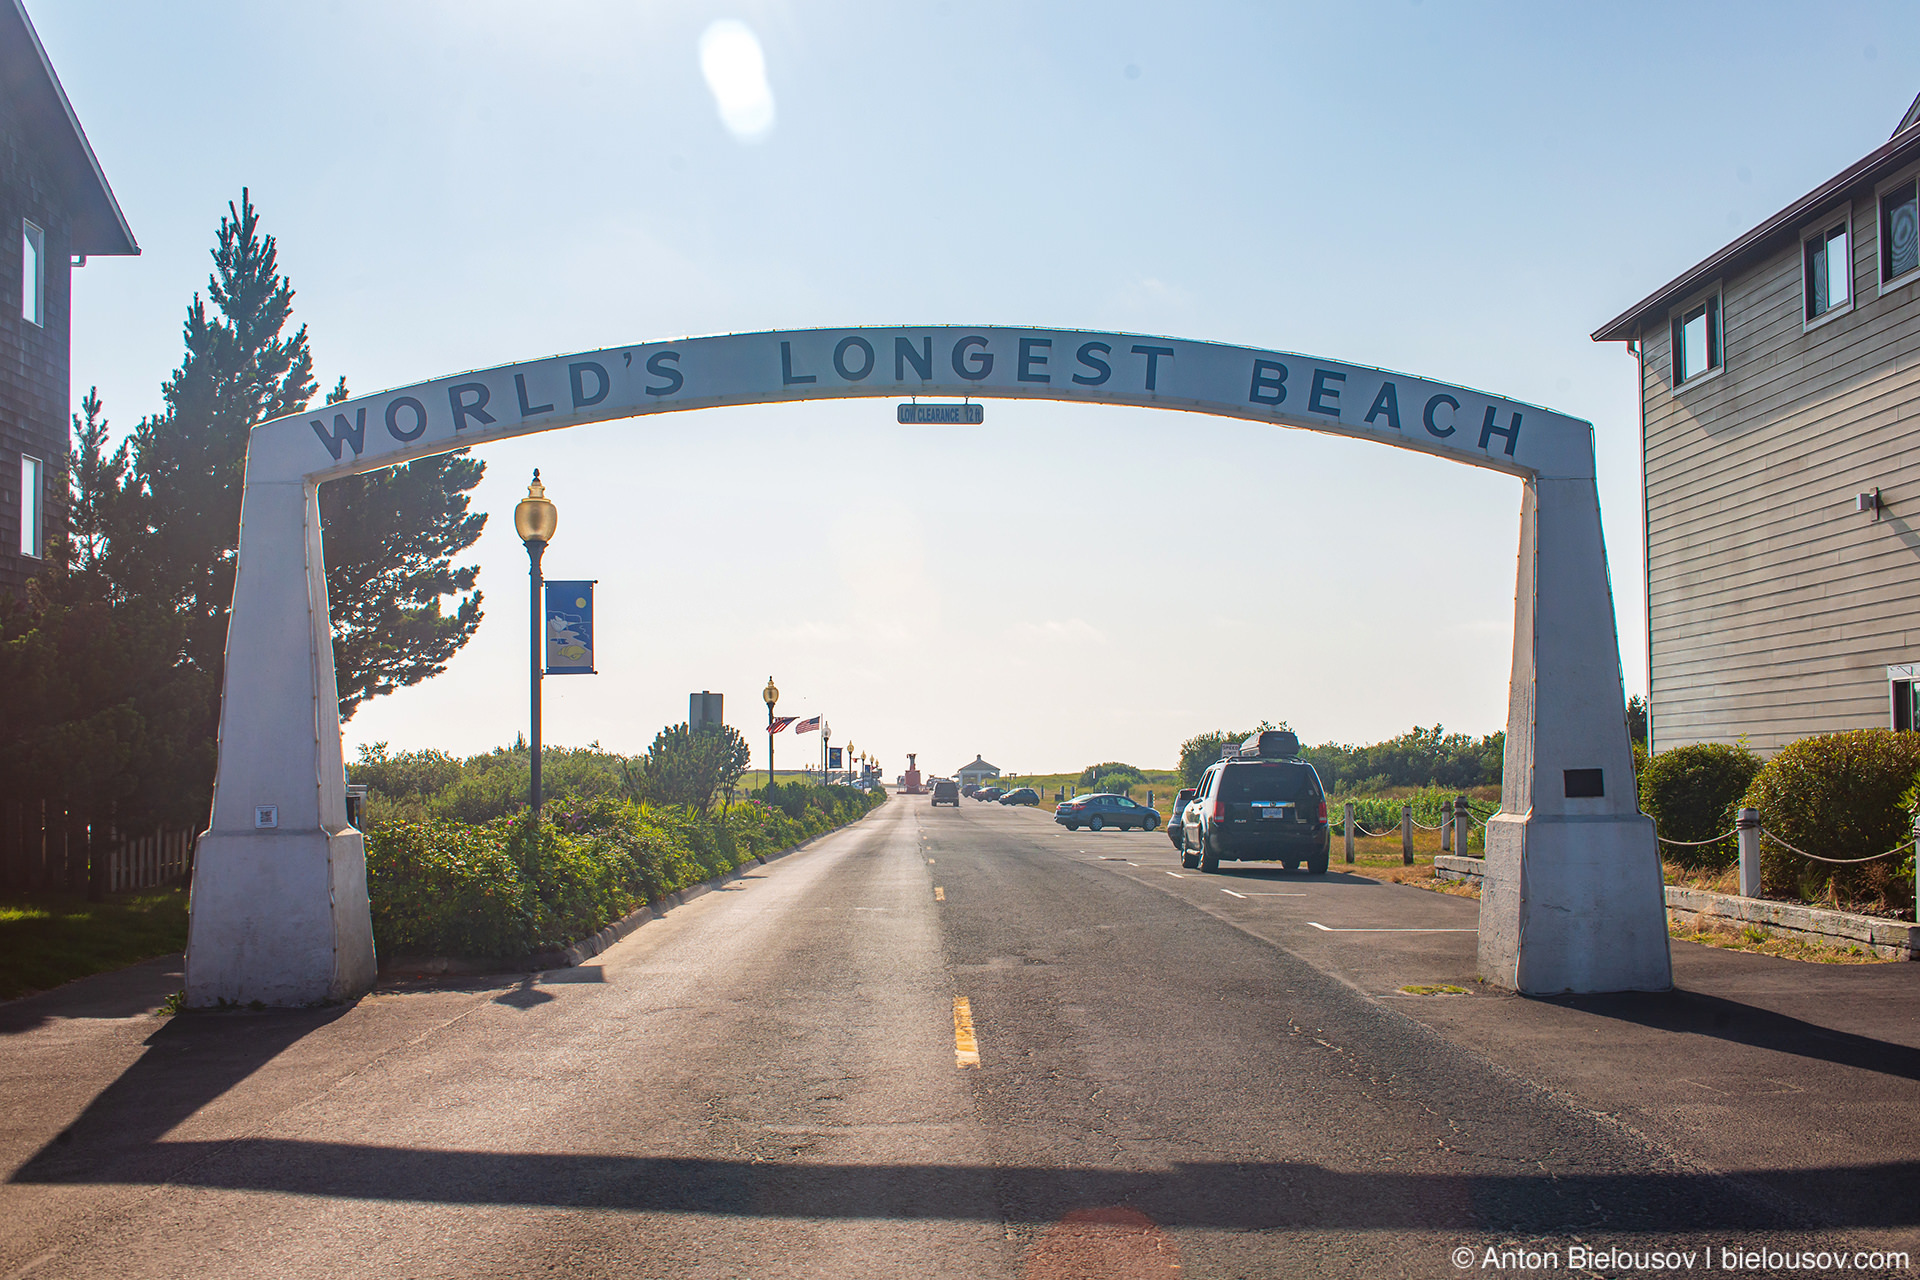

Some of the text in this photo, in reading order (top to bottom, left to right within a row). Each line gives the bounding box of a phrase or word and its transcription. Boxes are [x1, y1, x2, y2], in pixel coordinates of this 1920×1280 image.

[309, 335, 1523, 461] WORLD'S LONGEST BEACH
[900, 408, 916, 421] LOW
[917, 408, 959, 421] CLEARANCE
[966, 408, 974, 421] 12
